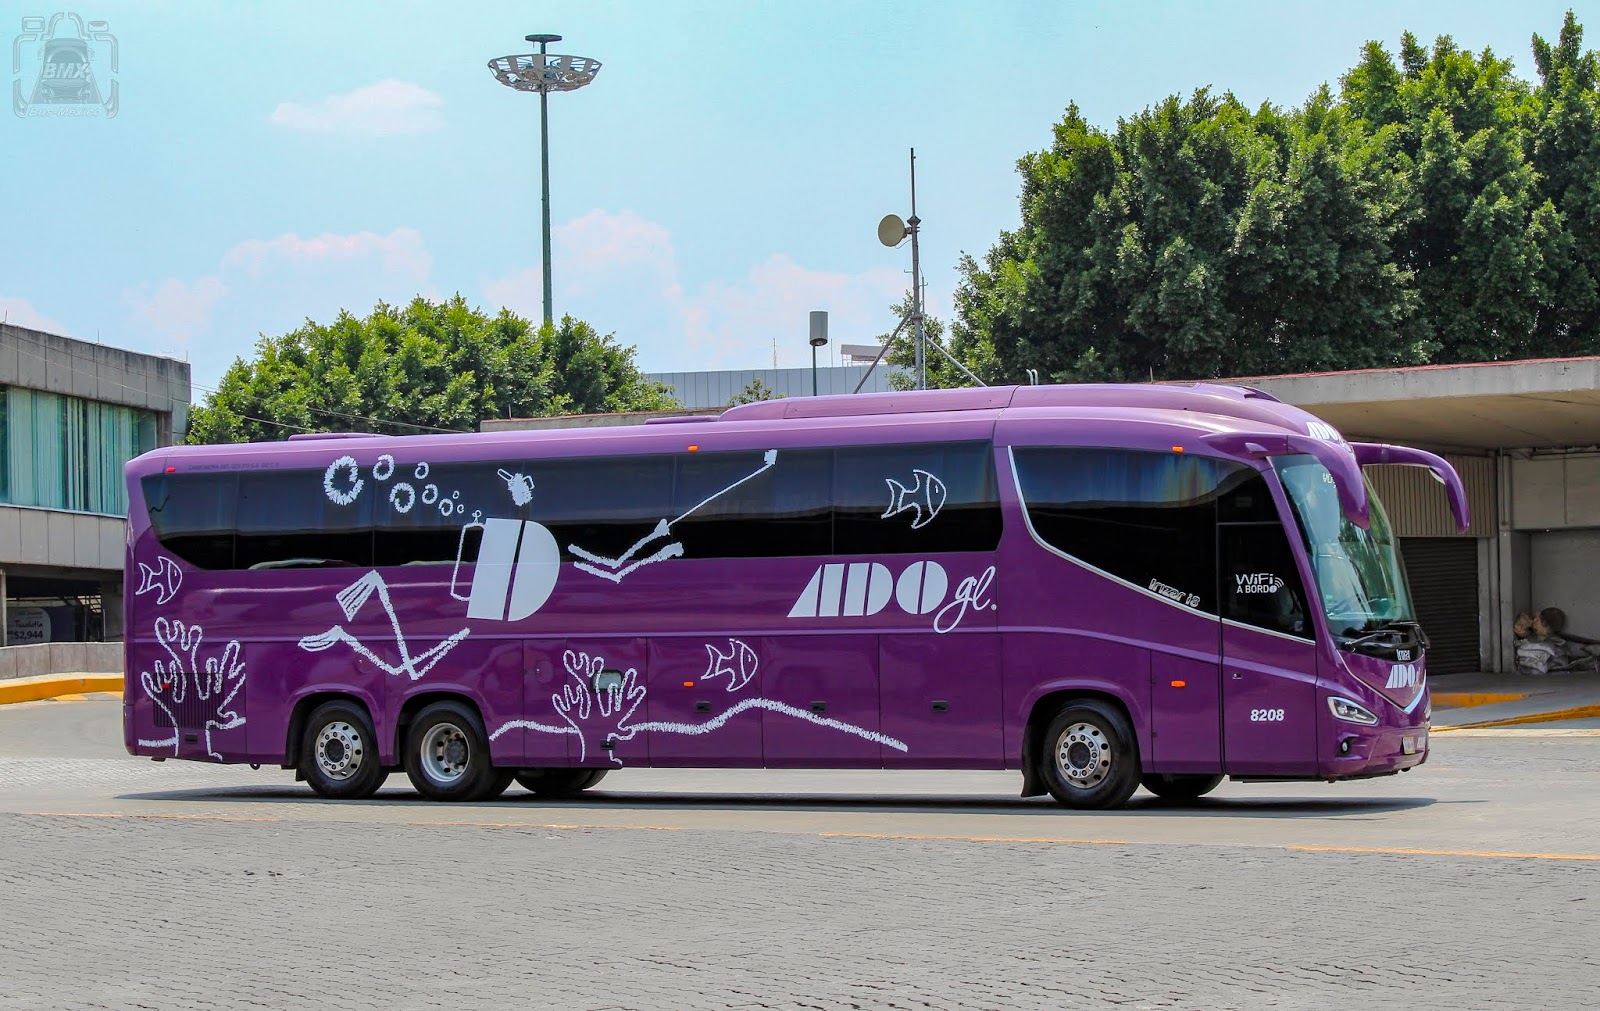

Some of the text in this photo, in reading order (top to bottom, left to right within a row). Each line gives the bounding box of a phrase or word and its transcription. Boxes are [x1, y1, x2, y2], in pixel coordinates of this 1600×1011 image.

[1235, 572, 1274, 585] WiFi
[1236, 584, 1244, 594] A
[1250, 708, 1285, 722] 8208
